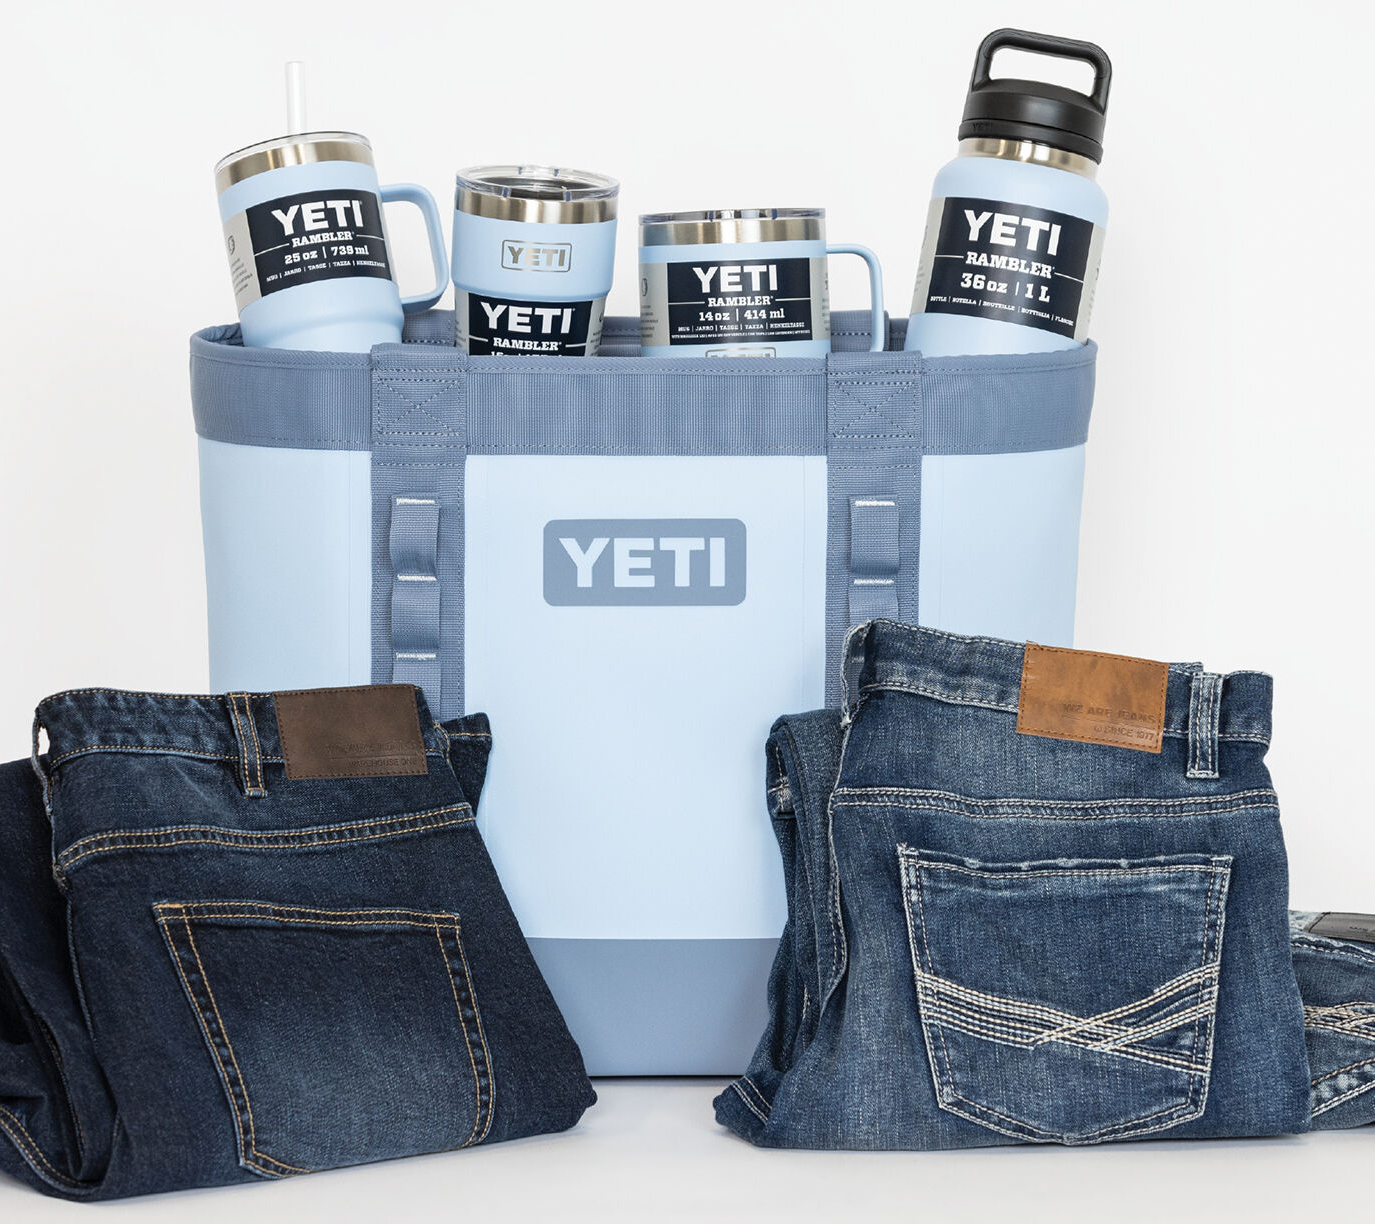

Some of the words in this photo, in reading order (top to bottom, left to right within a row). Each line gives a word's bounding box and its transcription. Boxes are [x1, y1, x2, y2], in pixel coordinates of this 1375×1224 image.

[271, 199, 364, 236] YETI
[291, 231, 354, 248] RAMBLER
[963, 209, 1062, 257] YETI
[284, 253, 301, 265] 25
[302, 250, 318, 261] oz
[330, 244, 355, 257] 739
[354, 244, 370, 256] ml
[507, 245, 566, 267] YETI
[965, 251, 1053, 279] RAMBLER
[692, 264, 778, 294] YETI
[960, 272, 987, 291] 36
[986, 279, 1008, 294] oz
[1024, 282, 1034, 302] 1
[1038, 285, 1051, 303] L
[698, 309, 715, 321] 14
[715, 312, 730, 321] oz
[743, 309, 767, 320] 414
[769, 308, 785, 319] ml
[707, 296, 772, 307] RAMBLER
[480, 301, 574, 334] YETI
[493, 336, 559, 351] RAMBLER
[558, 537, 725, 588] YETI
